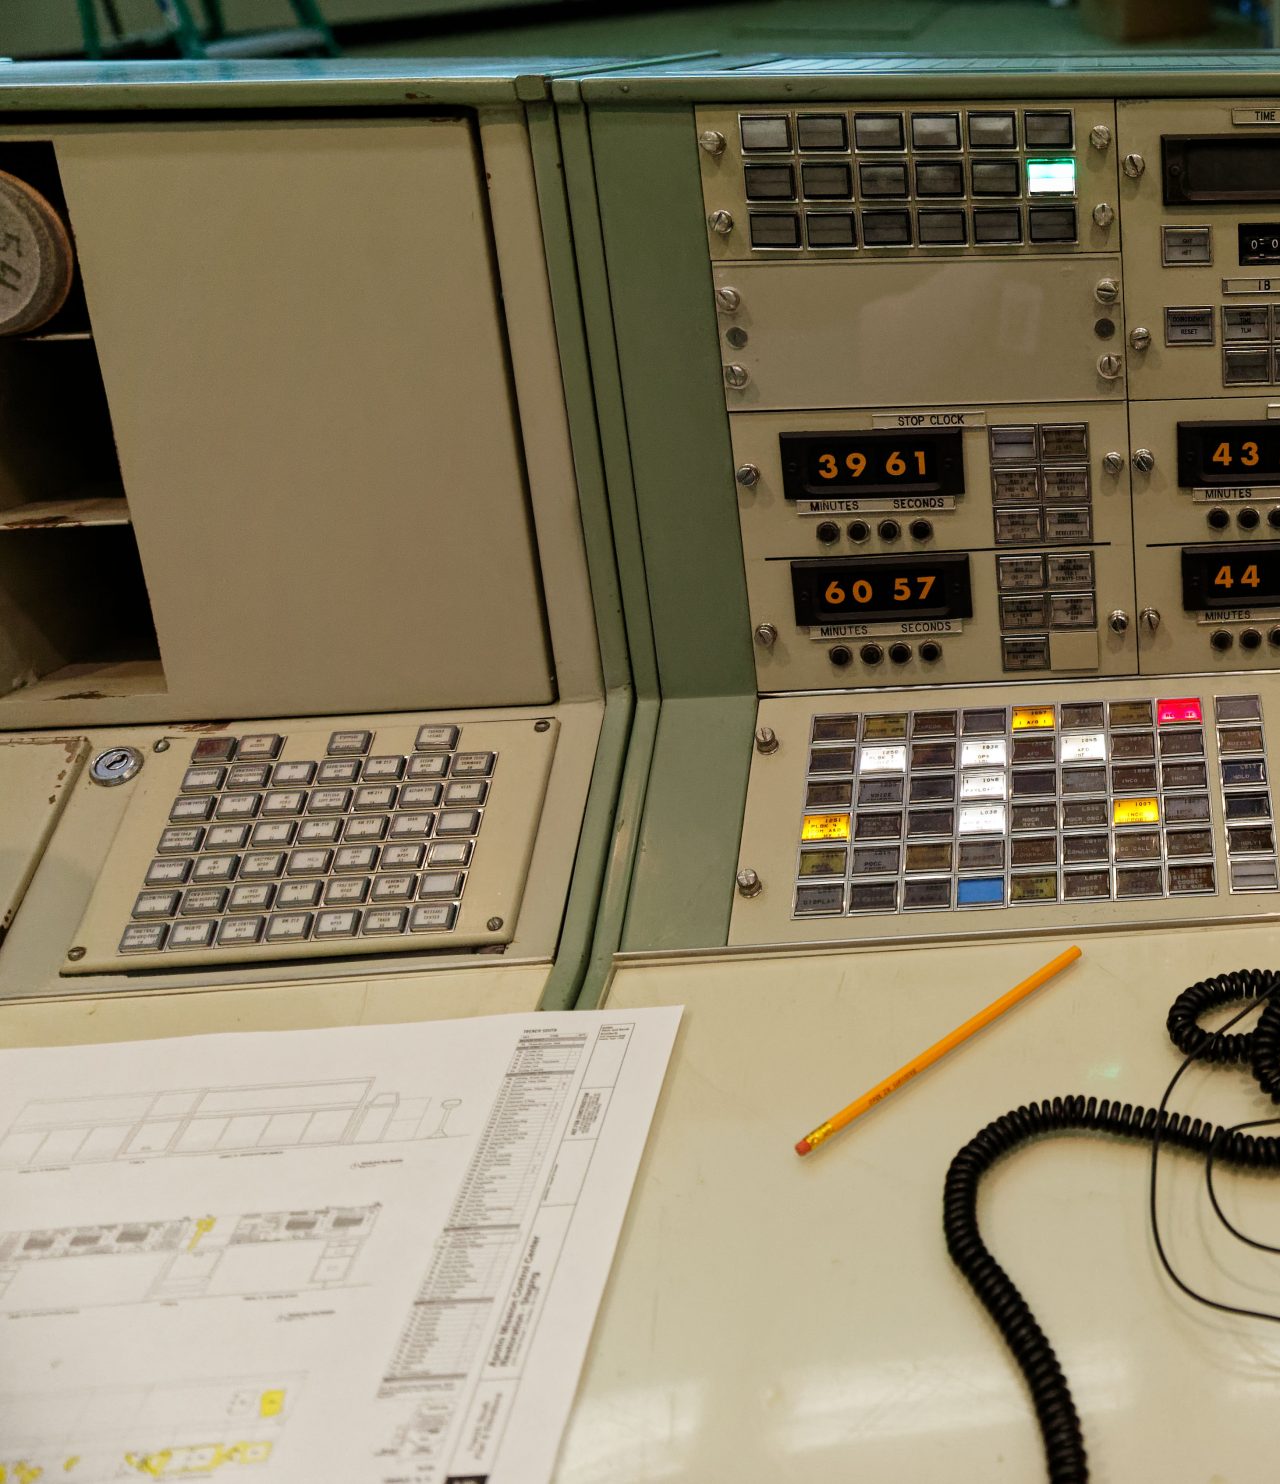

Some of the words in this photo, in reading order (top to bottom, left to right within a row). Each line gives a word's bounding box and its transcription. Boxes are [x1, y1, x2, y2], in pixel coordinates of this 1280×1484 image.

[1255, 111, 1278, 121] TIME
[898, 414, 926, 426] STOP
[930, 413, 965, 425] CLOCK
[1205, 488, 1252, 499] MINUTES
[810, 500, 859, 512] MINUTES
[893, 497, 944, 509] SECONDS
[1205, 610, 1251, 621] MINUTES
[820, 624, 868, 636] MINUTES
[901, 621, 952, 633] SECONDS
[513, 1265, 531, 1299] Control
